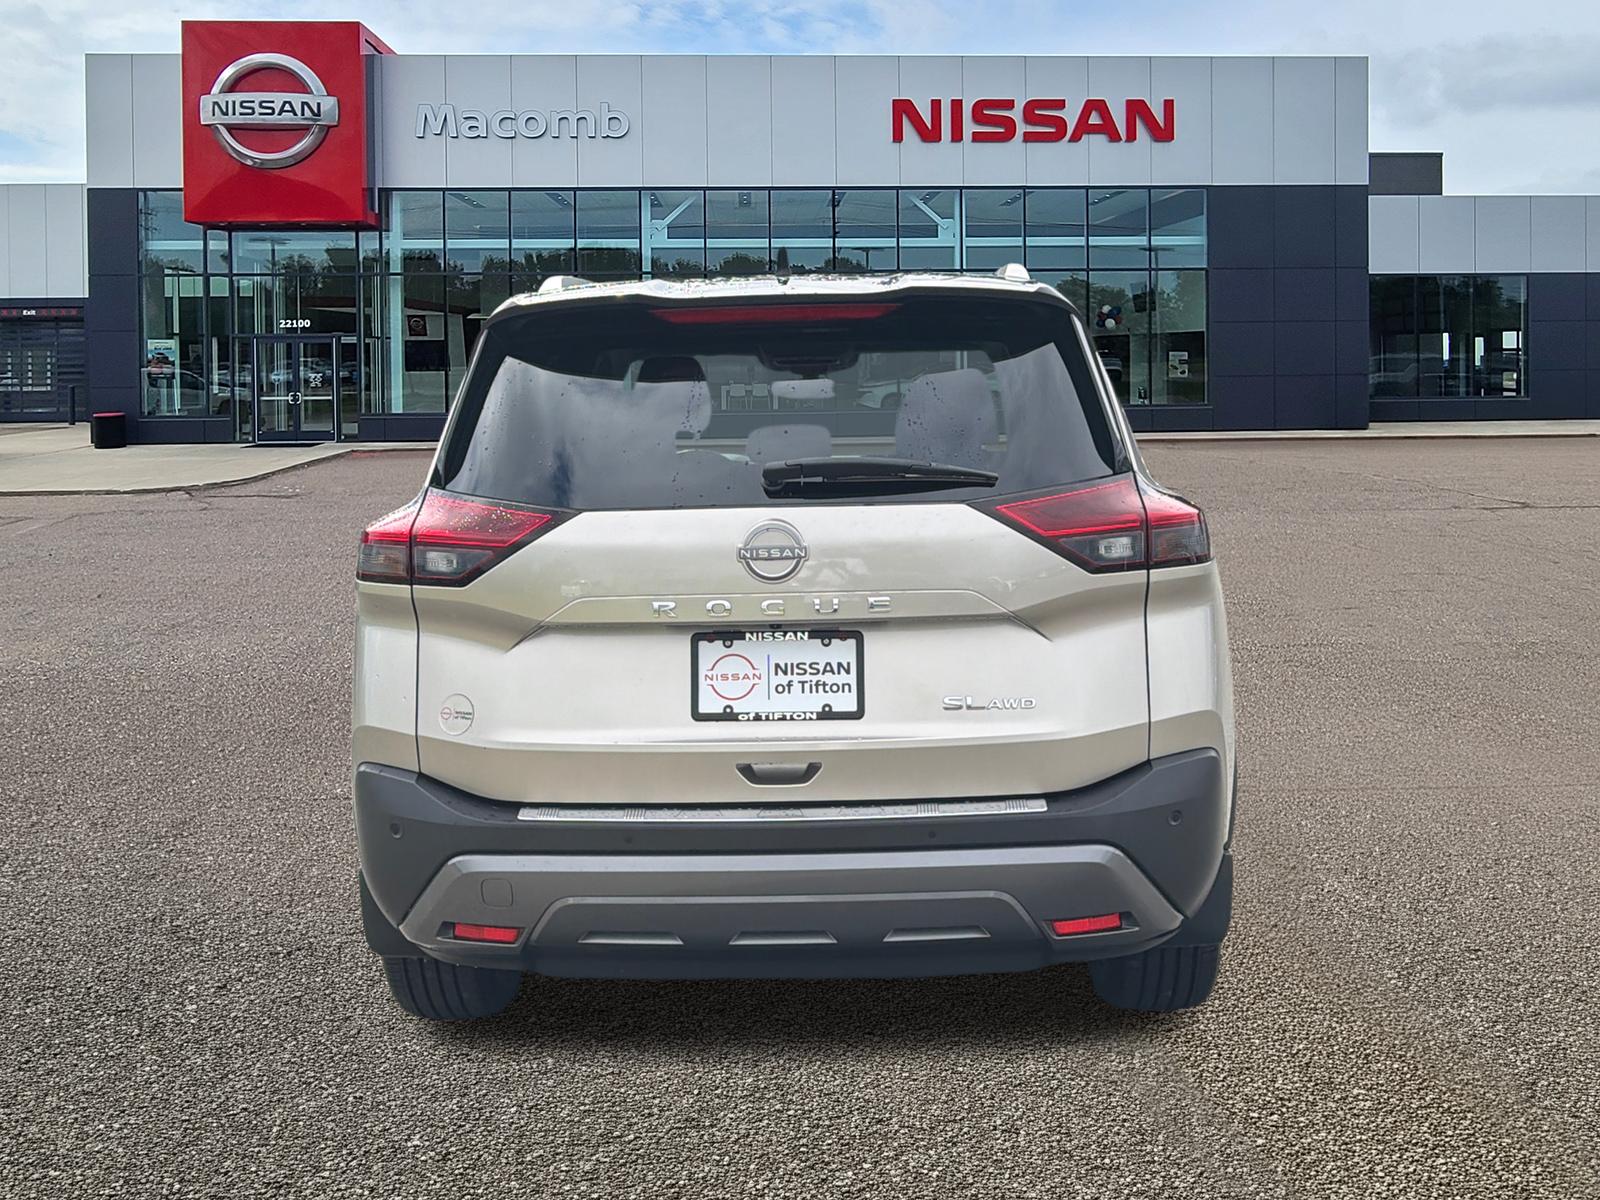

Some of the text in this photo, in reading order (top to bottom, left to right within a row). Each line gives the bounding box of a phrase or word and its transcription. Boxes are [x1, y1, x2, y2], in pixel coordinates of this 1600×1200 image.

[211, 99, 322, 118] NISSAN
[415, 101, 630, 139] Macomb
[891, 98, 1175, 143] NISSAN
[279, 319, 311, 328] 22100
[740, 548, 806, 558] NISSAN
[651, 596, 892, 618] ROGUE
[745, 631, 809, 642] NISSAN
[774, 661, 851, 676] NISSAN
[704, 673, 762, 681] NISSAN
[774, 679, 852, 694] of Tifton
[738, 711, 817, 721] of TIFTON
